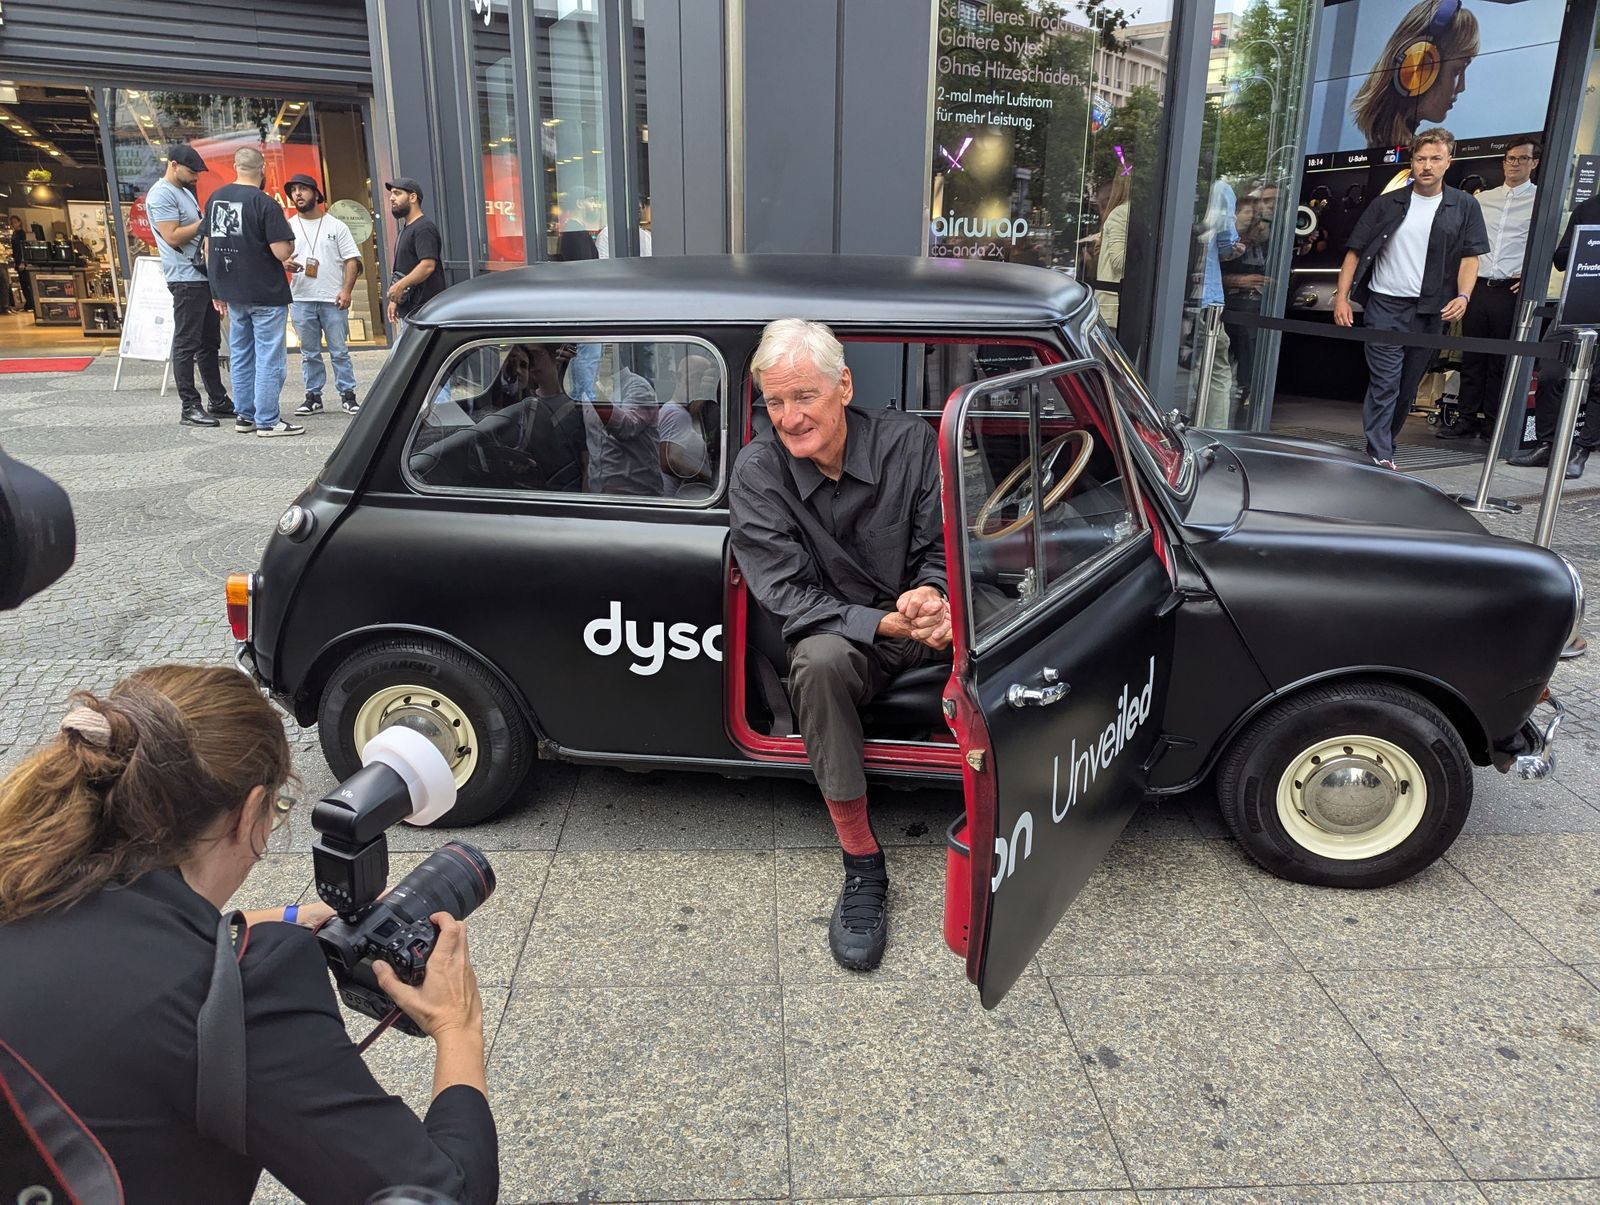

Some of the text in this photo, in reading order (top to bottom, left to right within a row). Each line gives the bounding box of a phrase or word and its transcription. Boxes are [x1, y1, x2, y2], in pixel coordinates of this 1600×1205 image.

[938, 27, 1047, 58] Glattere Styles.
[937, 55, 982, 77] Ohne
[937, 86, 1053, 109] 2-mal mehr Lufstrom
[936, 107, 1035, 131] für mehr Leistung.
[1308, 158, 1324, 167] 18:14
[1348, 155, 1368, 163] U-Bahn
[931, 209, 1029, 246] airwrap
[931, 242, 1005, 258] co-anda 2x
[1051, 655, 1155, 824] Unveiled
